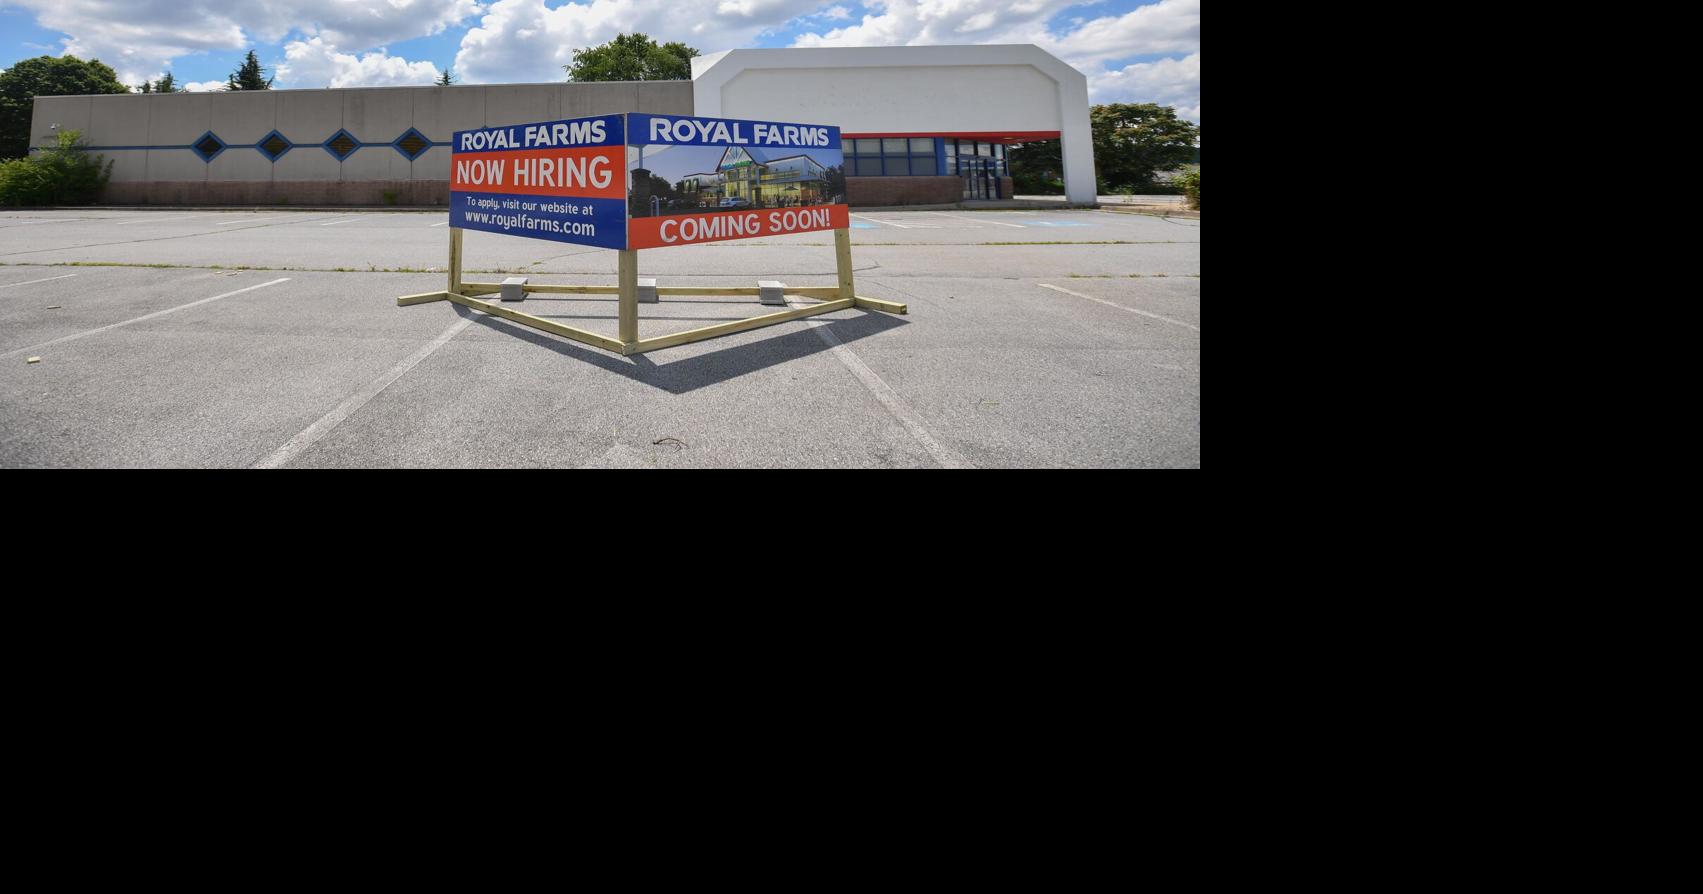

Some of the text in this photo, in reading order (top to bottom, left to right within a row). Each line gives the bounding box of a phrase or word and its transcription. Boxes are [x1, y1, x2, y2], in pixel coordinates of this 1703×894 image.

[461, 119, 607, 151] ROYAL FARMS
[650, 117, 830, 146] ROYAL FARMS
[456, 155, 613, 189] NOW HIRING
[466, 196, 476, 206] To
[502, 200, 519, 210] visit
[522, 203, 536, 211] our
[540, 203, 579, 215] website
[582, 205, 593, 216] at
[465, 211, 595, 237] www.royalfarms.com
[659, 207, 831, 243] COMING SOON!
